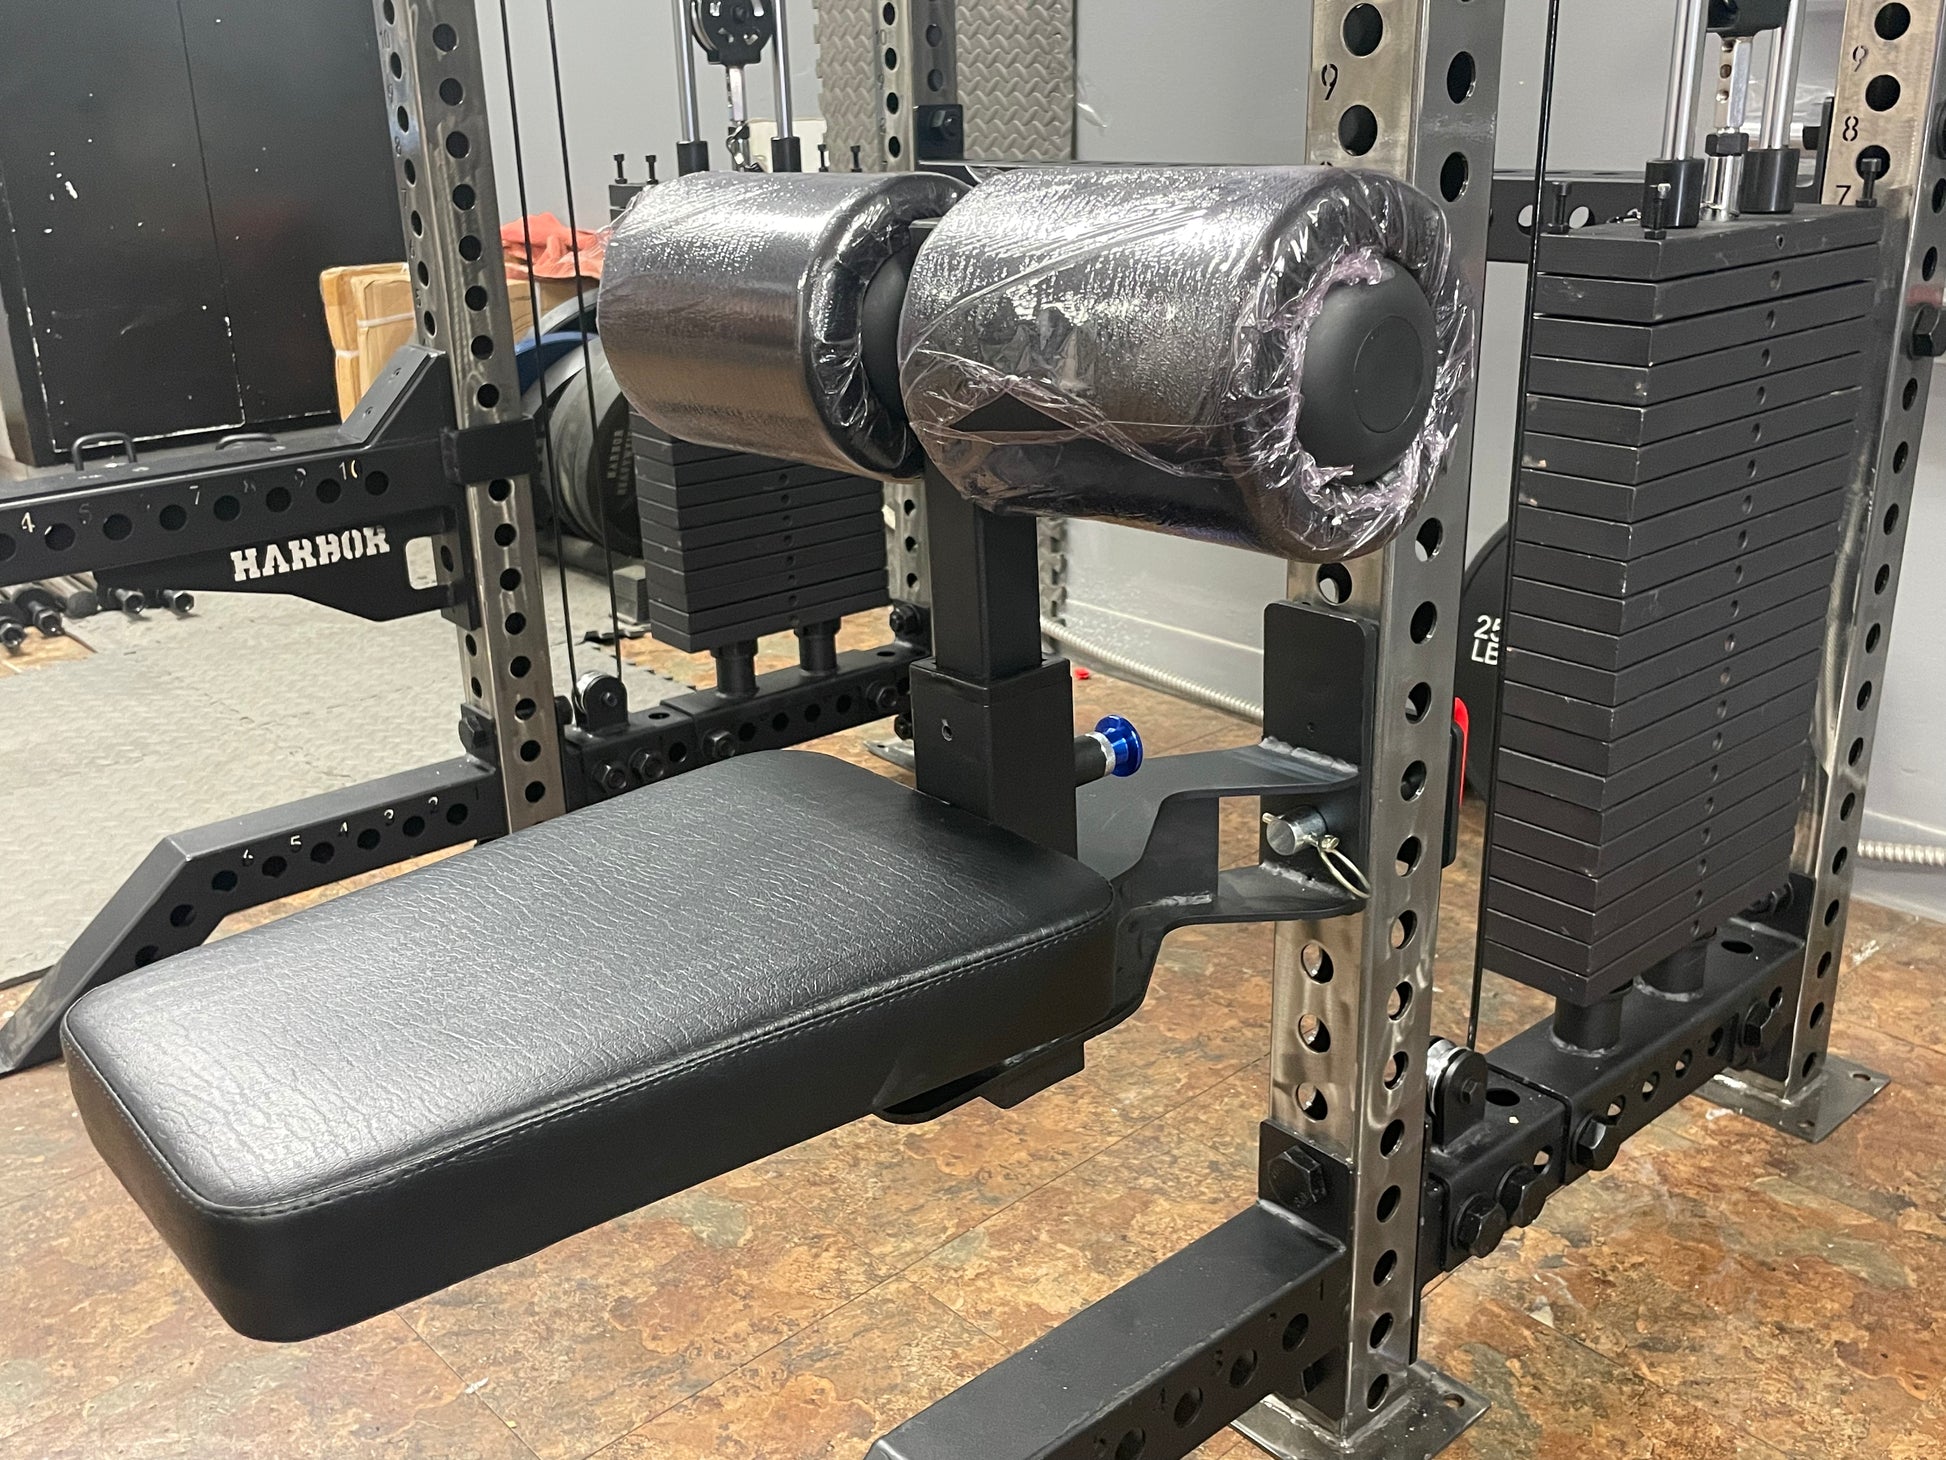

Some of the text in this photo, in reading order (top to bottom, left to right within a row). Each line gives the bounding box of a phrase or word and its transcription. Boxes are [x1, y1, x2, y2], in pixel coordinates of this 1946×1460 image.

[1852, 44, 1868, 72] 9
[1321, 63, 1339, 101] 9
[1842, 116, 1859, 142] 8
[1835, 185, 1852, 206] 7
[21, 511, 36, 534] 4
[188, 484, 201, 505] 7
[338, 459, 363, 481] 10
[229, 526, 391, 582] HARBOR
[290, 834, 302, 854] 5
